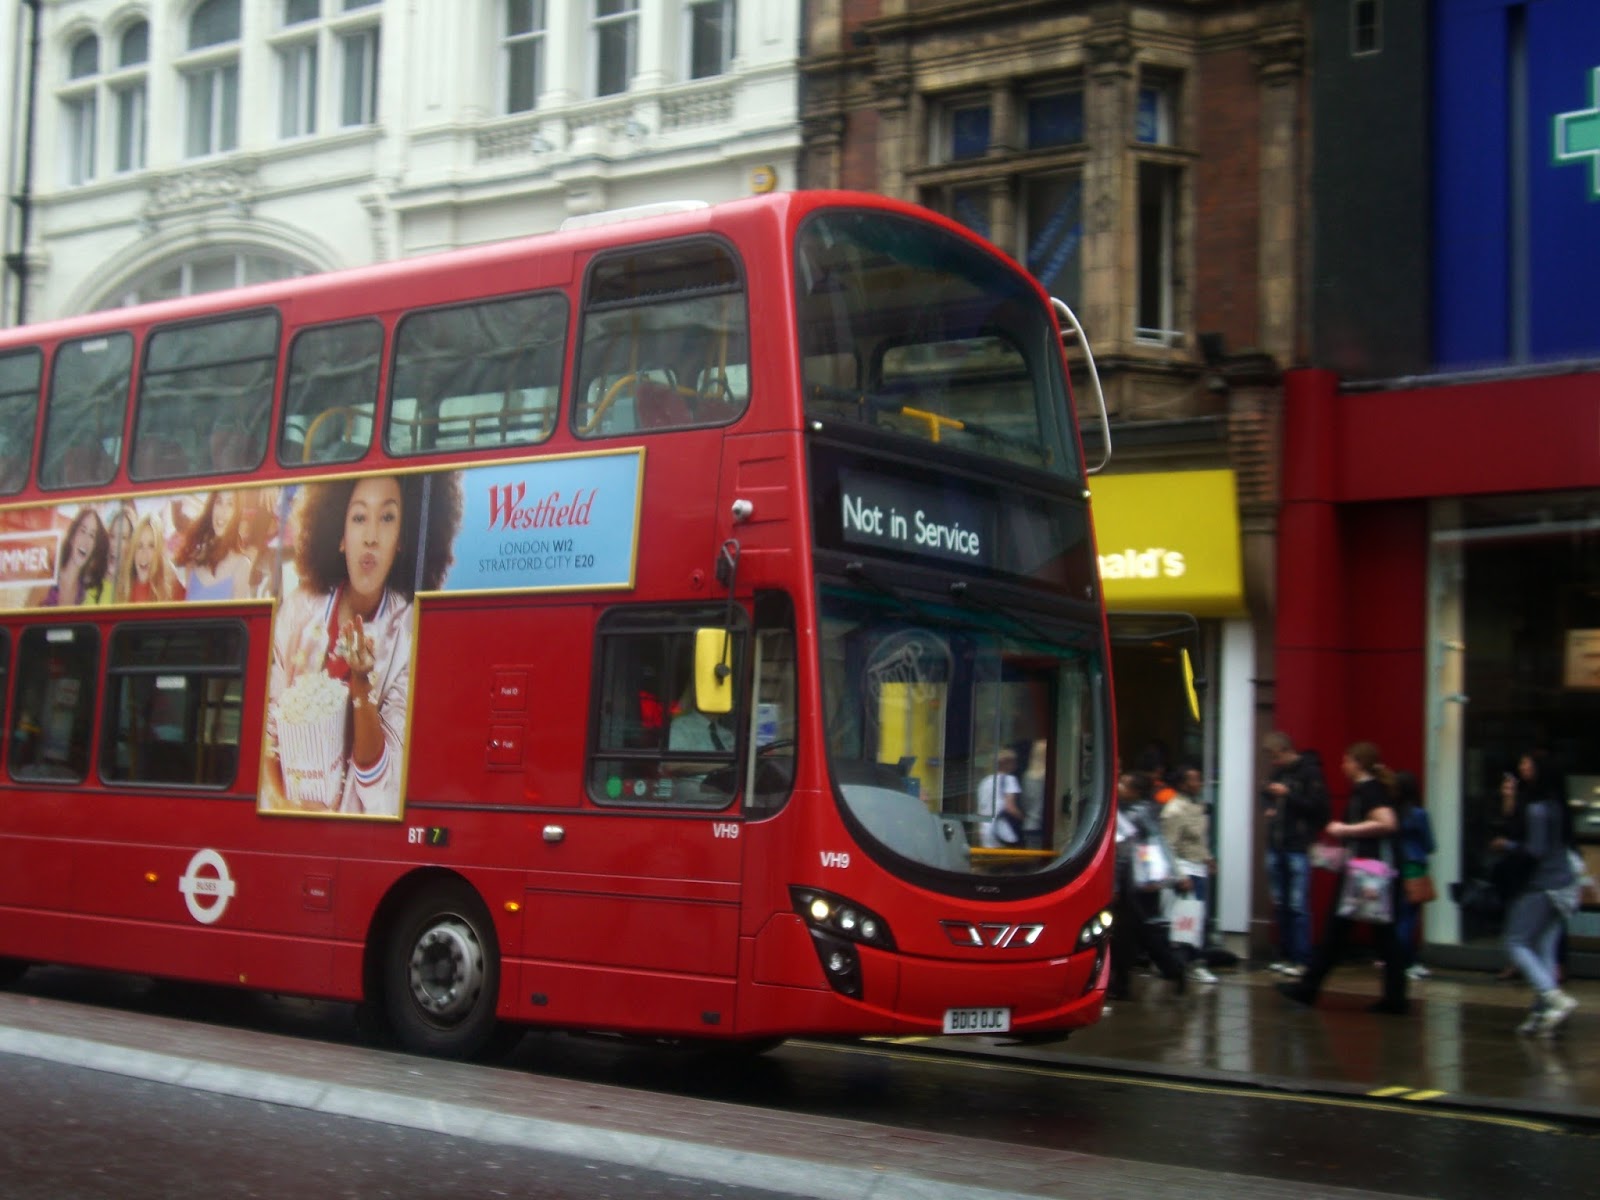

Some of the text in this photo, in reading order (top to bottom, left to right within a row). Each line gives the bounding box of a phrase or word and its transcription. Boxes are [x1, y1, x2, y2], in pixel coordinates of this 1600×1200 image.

[488, 480, 599, 532] Westfield
[842, 493, 980, 556] Not in Service
[499, 539, 573, 556] LONDON W12
[0, 547, 49, 573] MMER
[478, 554, 594, 573] STRATFORD CITY E20
[408, 827, 441, 843] BT 7
[713, 822, 740, 839] VH9
[820, 851, 850, 869] VH9
[952, 1010, 978, 1030] BD13
